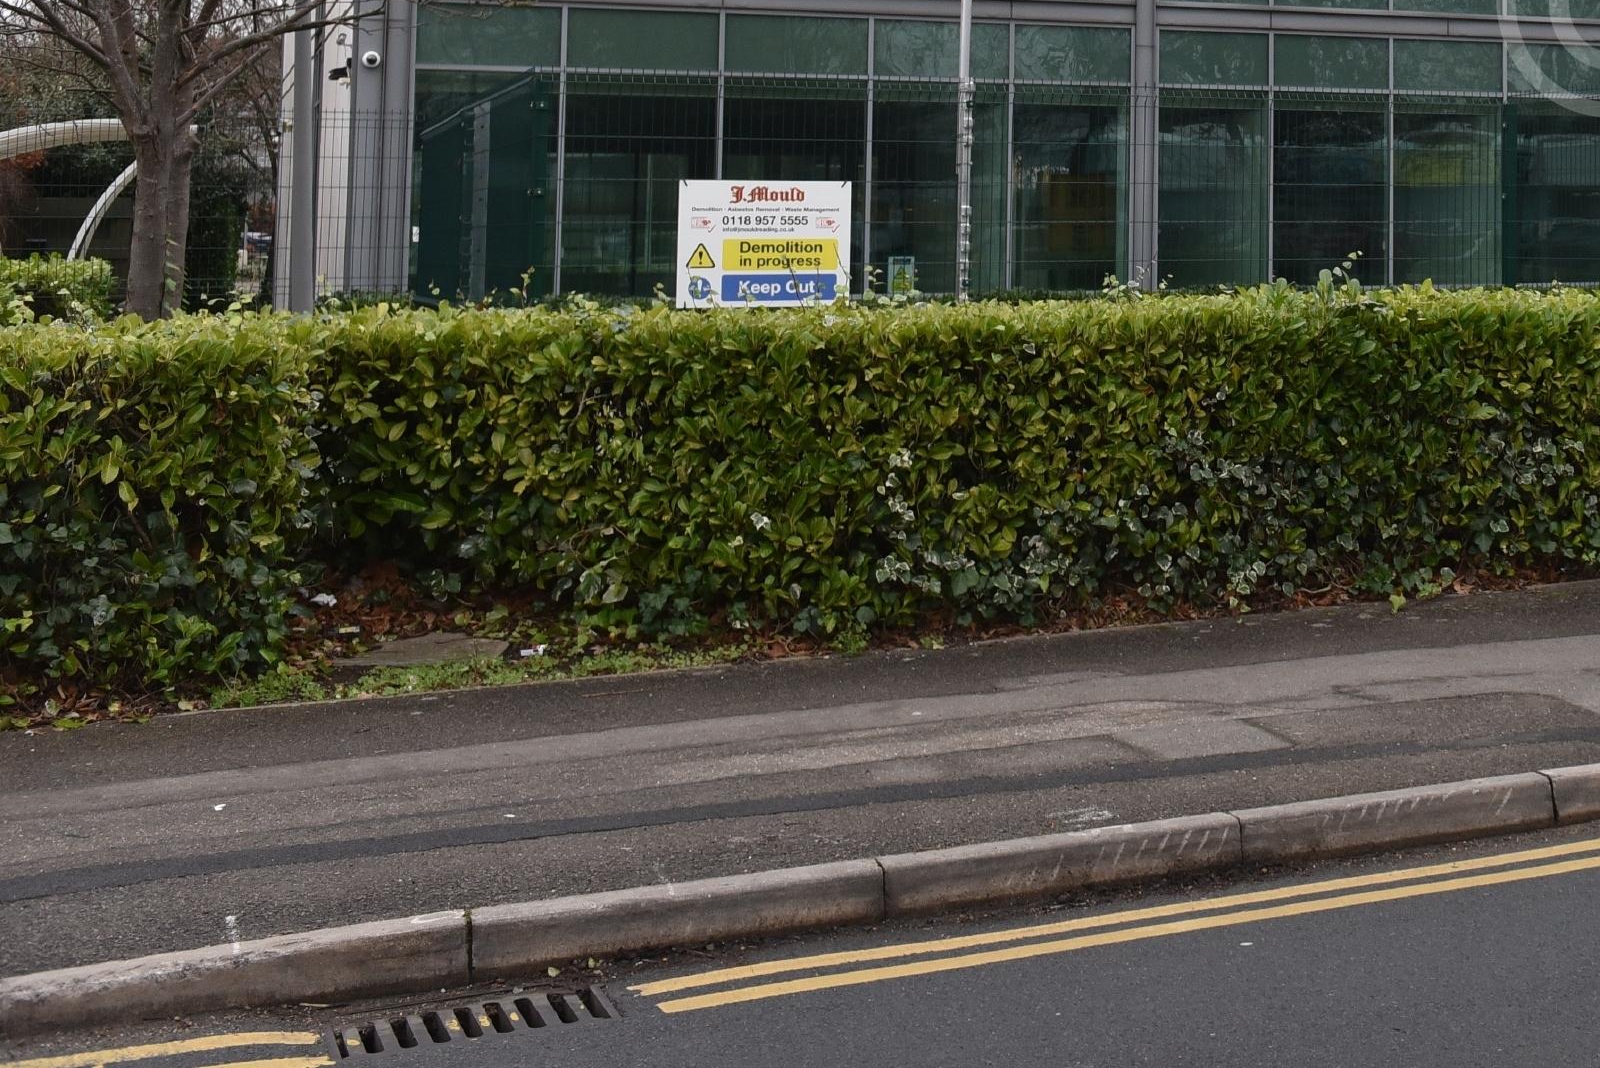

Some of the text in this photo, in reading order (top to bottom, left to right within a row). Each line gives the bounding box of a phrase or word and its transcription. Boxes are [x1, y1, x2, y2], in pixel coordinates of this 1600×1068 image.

[722, 215, 808, 226] 0118 957 5555
[739, 241, 823, 254] Demolition
[739, 256, 821, 269] in progress
[739, 280, 816, 296] Keep Out
